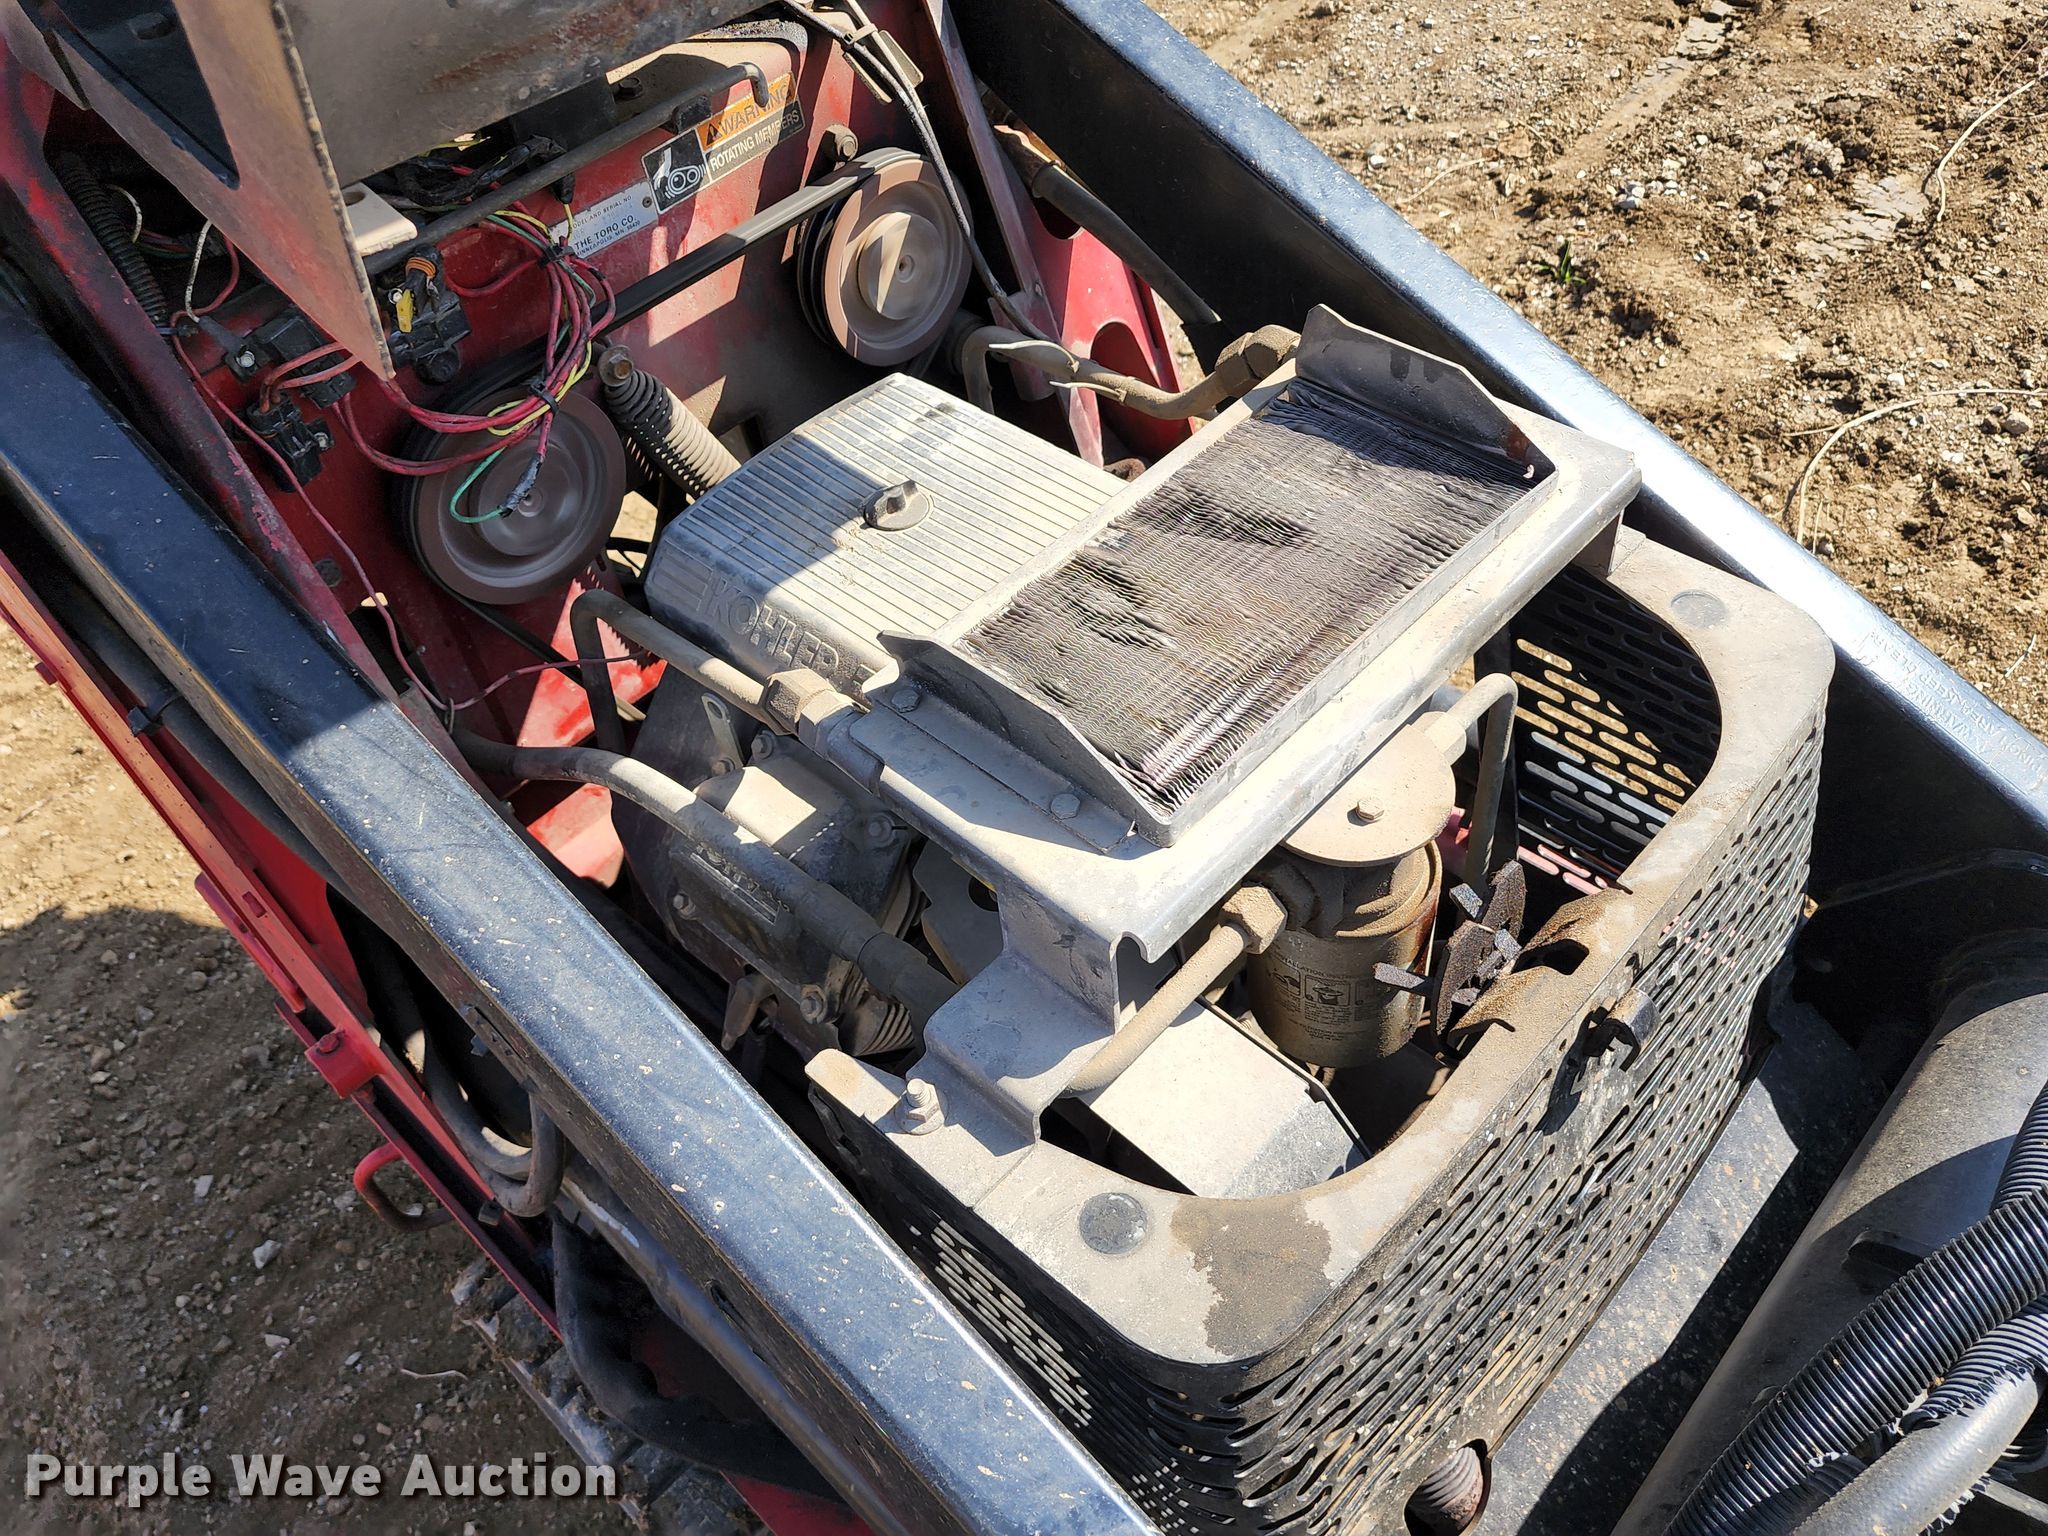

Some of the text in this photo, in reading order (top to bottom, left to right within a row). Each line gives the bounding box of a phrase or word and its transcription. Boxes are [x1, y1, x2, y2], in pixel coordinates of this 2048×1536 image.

[710, 110, 800, 171] ROTATING MEMBERS
[588, 210, 602, 221] AND
[601, 199, 622, 214] SERIAL
[573, 212, 636, 250] THE TORO CO.
[698, 576, 844, 688] KOHLER
[1916, 669, 1957, 705] KEEP
